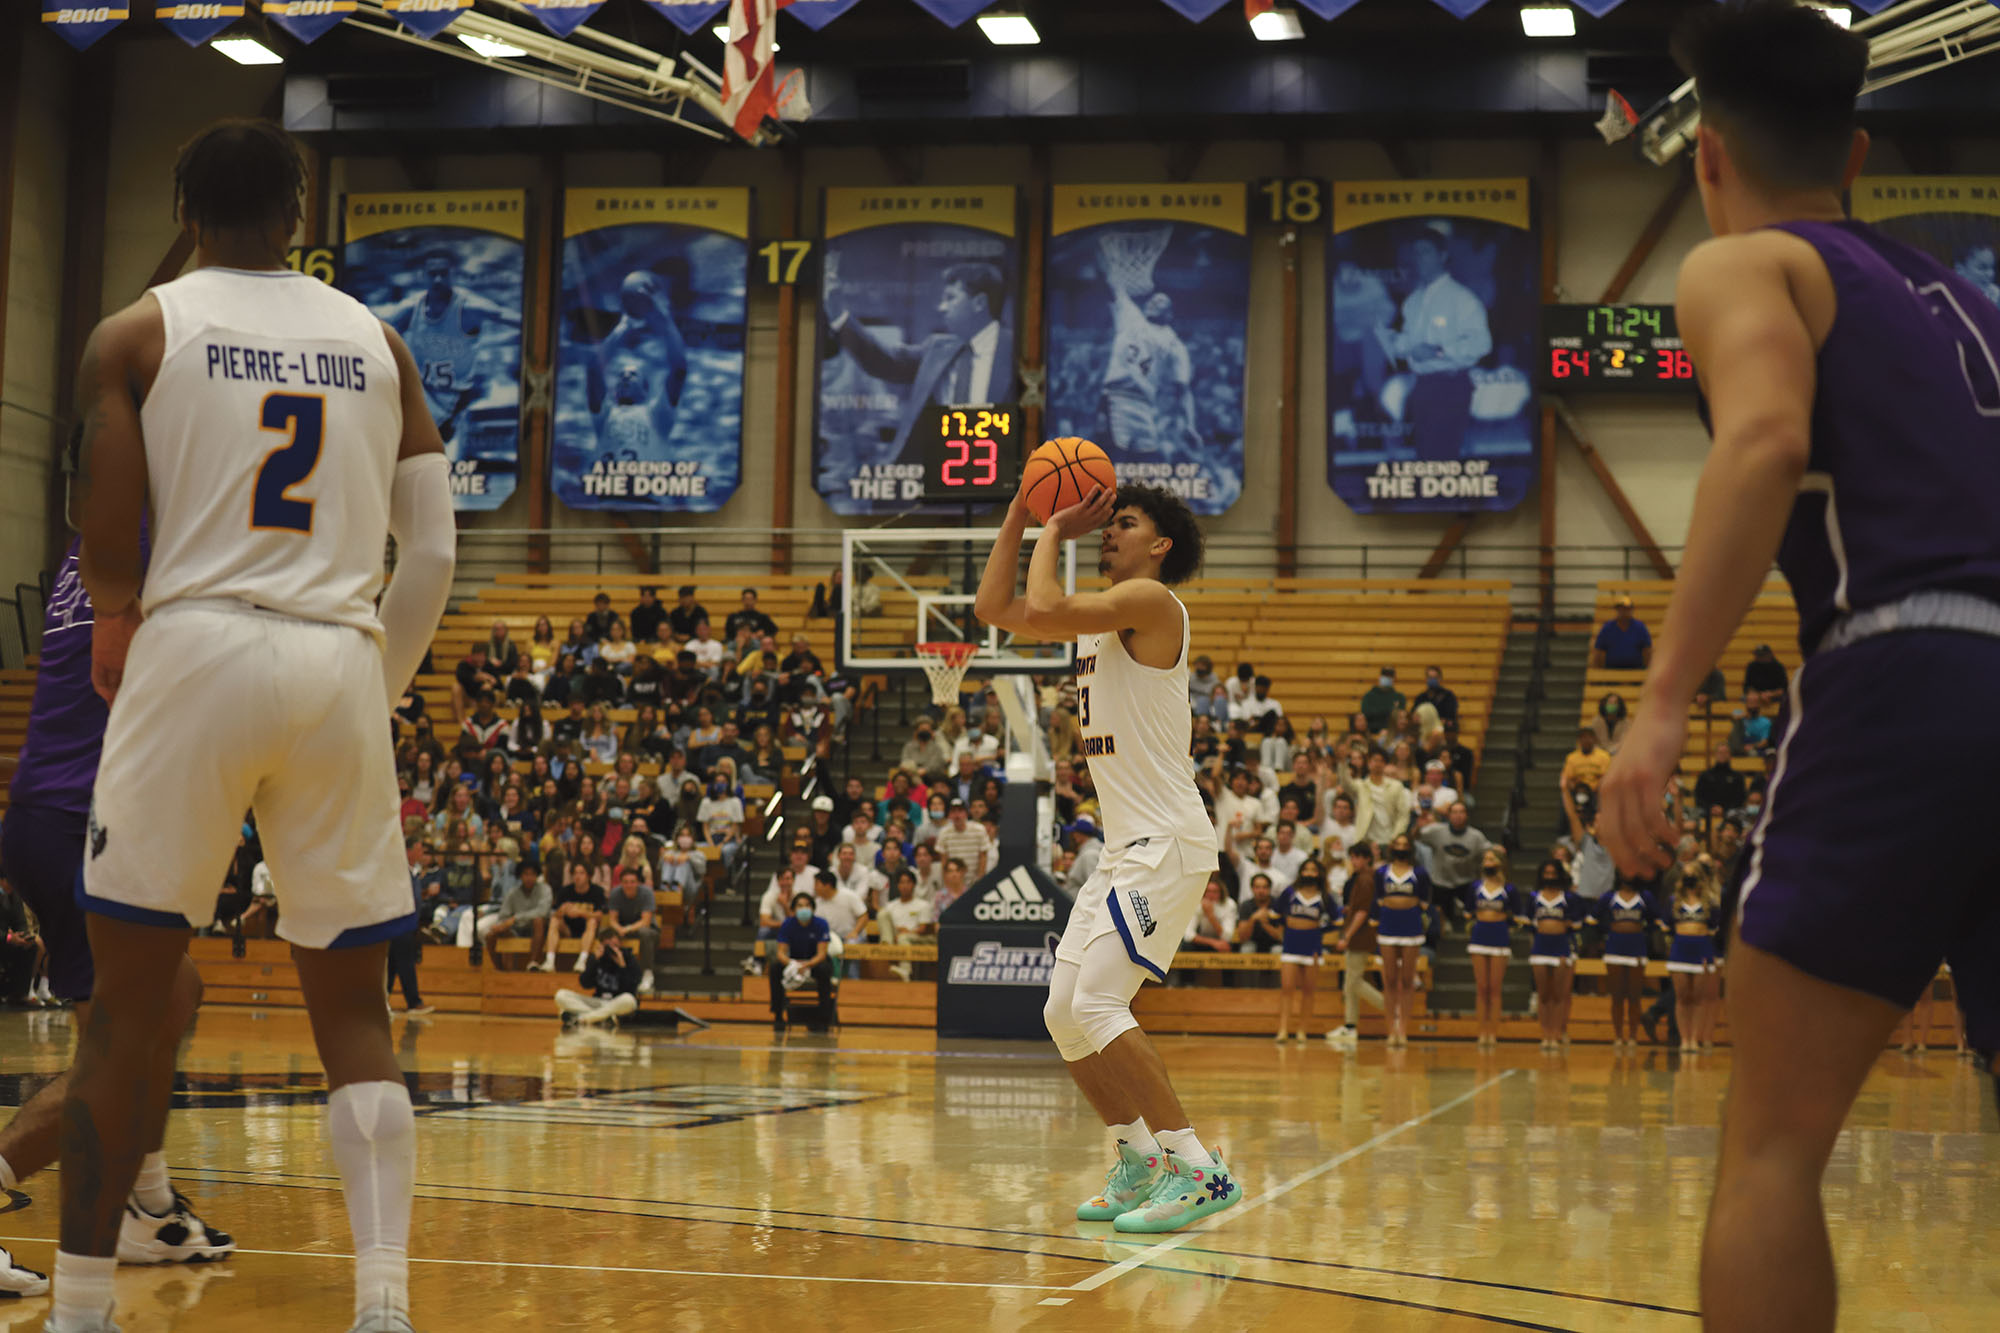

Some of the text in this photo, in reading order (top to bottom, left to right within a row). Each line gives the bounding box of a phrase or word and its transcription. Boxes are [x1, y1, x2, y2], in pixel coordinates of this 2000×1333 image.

[56, 7, 109, 24] 2010
[172, 3, 221, 20] 2011
[1261, 180, 1321, 223] 18
[285, 249, 335, 286] 16
[758, 241, 811, 283] 17
[206, 344, 366, 392] PIERRE-LOUIS
[1552, 349, 1590, 378] 64
[1611, 349, 1626, 368] 2
[248, 390, 327, 537] 2
[591, 460, 700, 476] A LEGEND OF
[859, 464, 872, 479] A
[941, 440, 998, 486] 23
[1175, 462, 1200, 478] OF
[1375, 460, 1490, 477] A LEGEND OF
[582, 475, 706, 497] THE DOME
[849, 479, 896, 500] THE
[1366, 475, 1499, 498] THE DOME
[973, 900, 1056, 921] adidas
